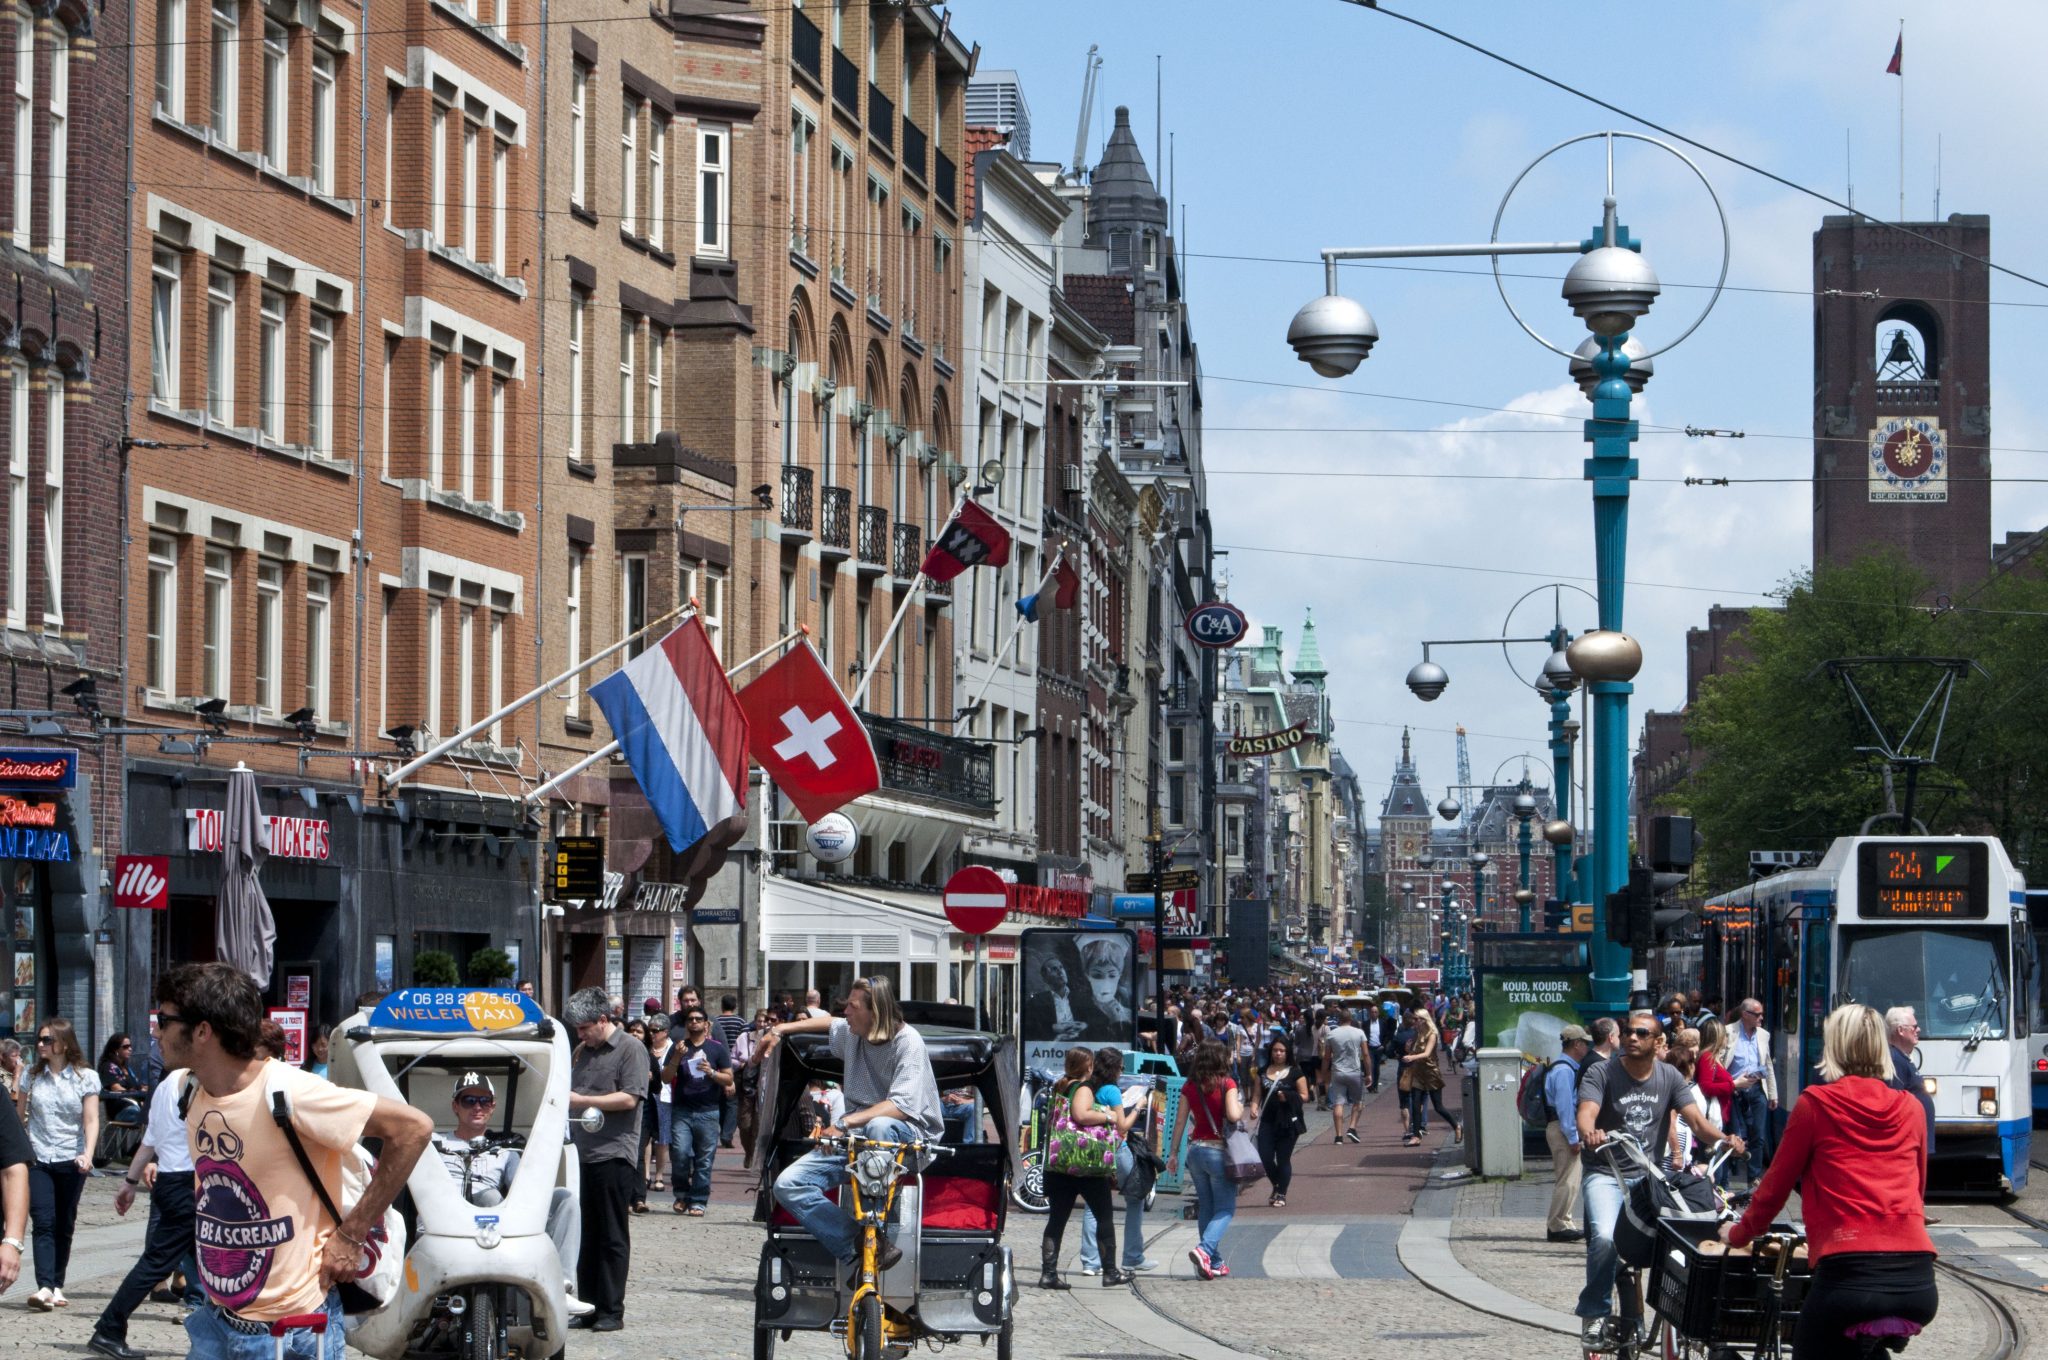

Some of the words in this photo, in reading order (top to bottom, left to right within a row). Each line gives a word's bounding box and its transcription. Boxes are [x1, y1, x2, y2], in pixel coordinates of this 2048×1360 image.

[1195, 614, 1236, 635] C&A
[1229, 729, 1302, 754] CASINO
[25, 829, 70, 861] PLAZA
[269, 816, 330, 860] TICKETS
[1889, 851, 1921, 879] 24
[117, 862, 166, 904] illy
[634, 883, 689, 912] CHANGE
[1892, 902, 1952, 912] centrum
[413, 993, 431, 1005] 06
[435, 993, 454, 1005] 28
[458, 993, 475, 1005] 24
[481, 993, 498, 1005] 75
[502, 993, 521, 1005] 50
[1502, 981, 1530, 992] KOUD,
[1532, 981, 1571, 992] KOUDER,
[1508, 992, 1537, 1003] EXTRA
[1539, 992, 1565, 1003] COLD.
[466, 1006, 515, 1020] TAXI
[200, 1222, 213, 1240] BE
[214, 1227, 223, 1243] A
[223, 1221, 288, 1246] SCREAM
